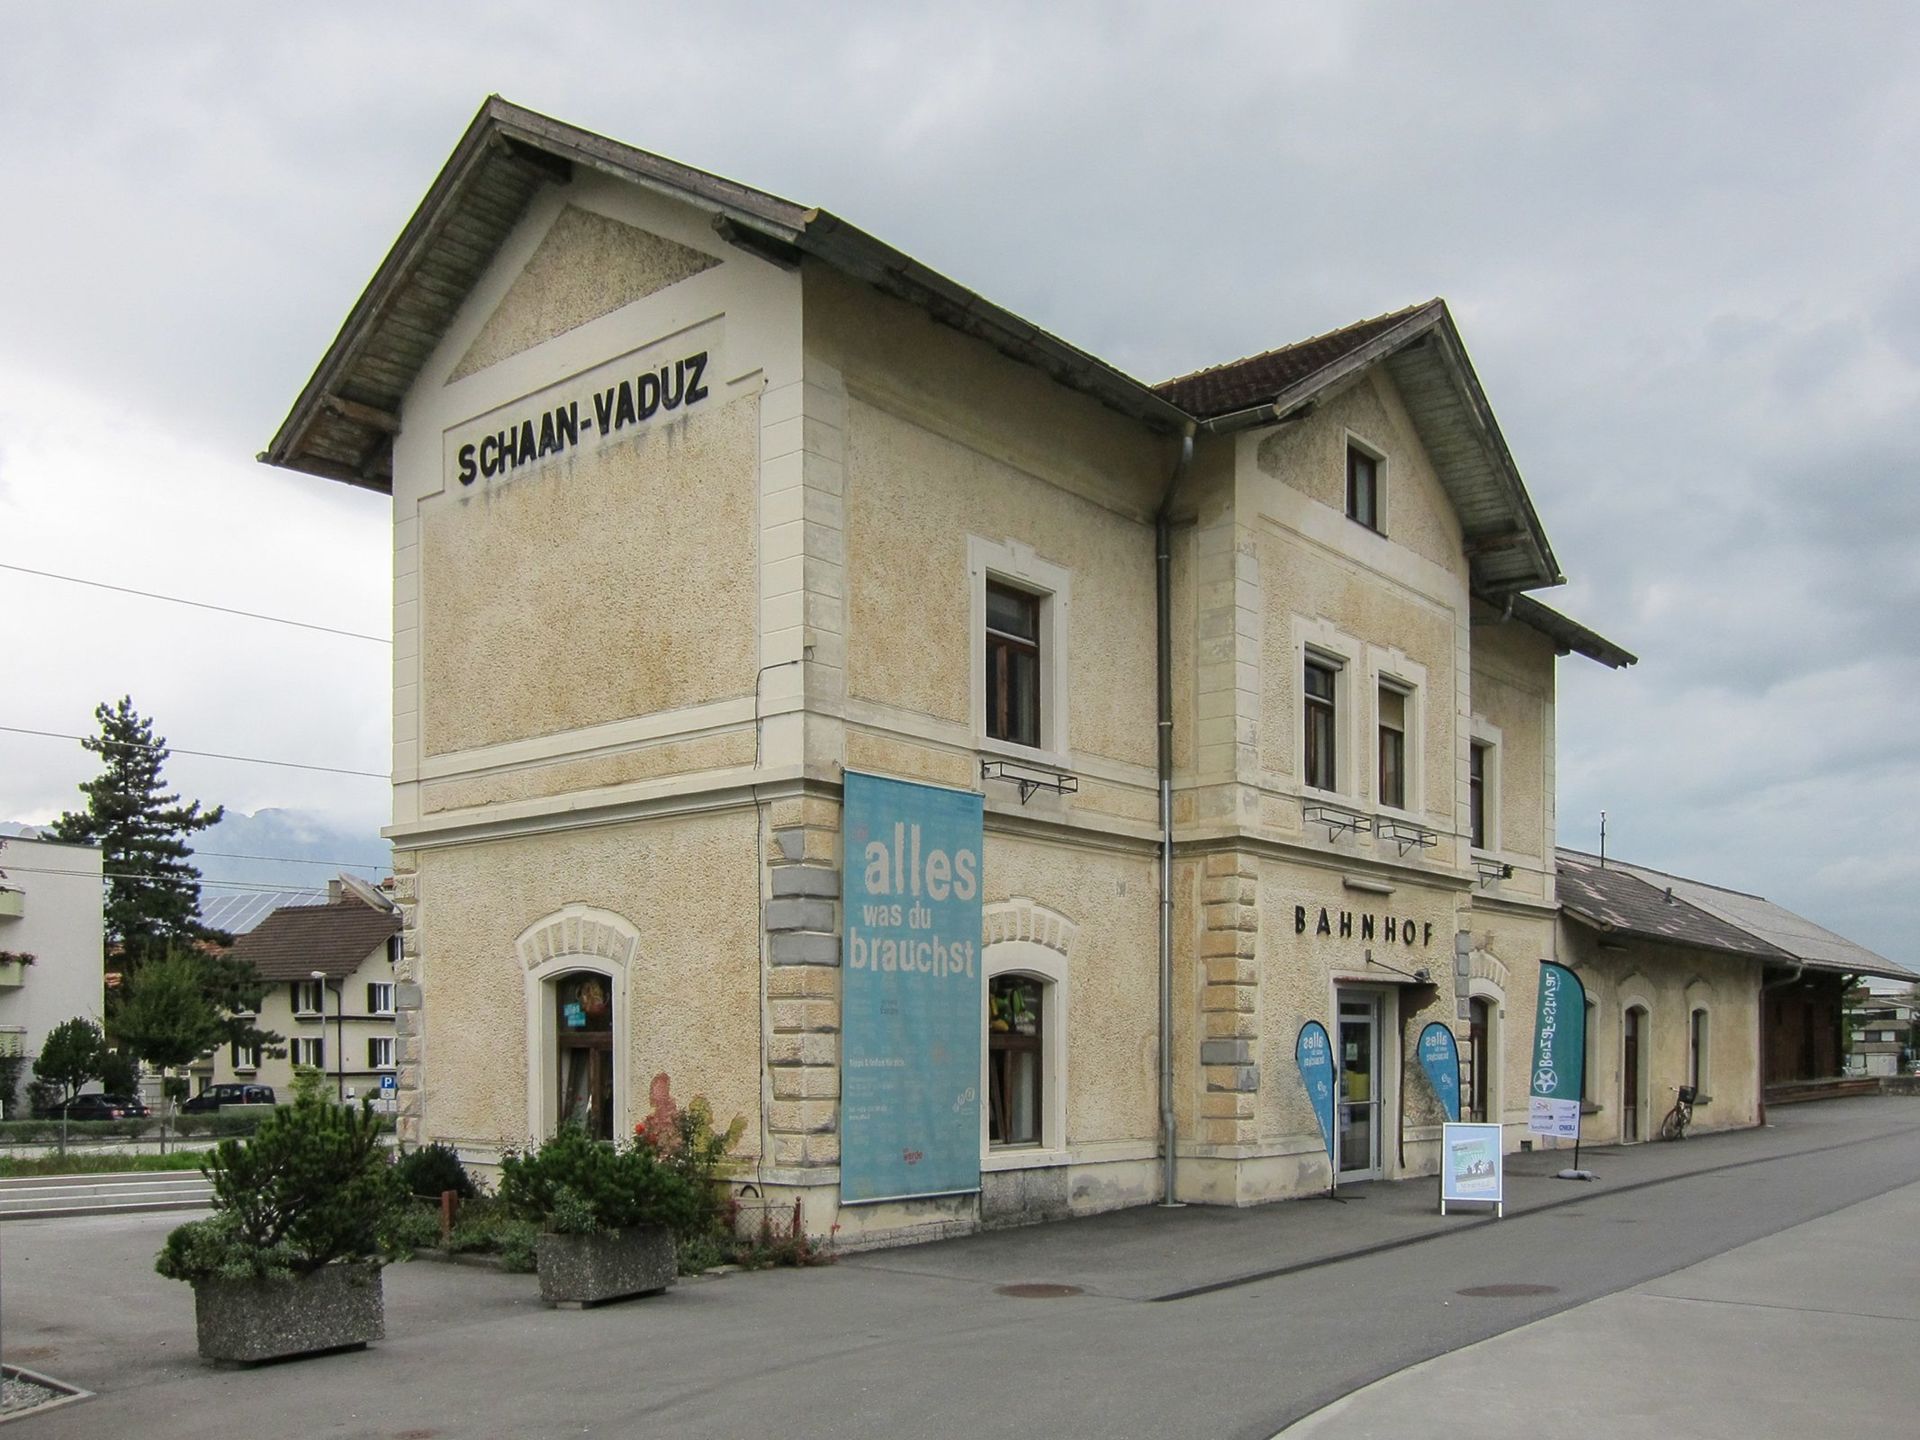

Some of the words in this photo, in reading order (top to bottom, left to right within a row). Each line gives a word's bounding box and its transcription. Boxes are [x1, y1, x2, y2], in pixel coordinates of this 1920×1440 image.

[458, 351, 708, 486] SCHAAN-VADUZ
[865, 822, 977, 900] alles
[863, 903, 902, 927] was
[909, 901, 932, 929] du
[1295, 905, 1433, 946] BAHNHOF
[850, 927, 975, 978] brauchst
[385, 1077, 392, 1088] P
